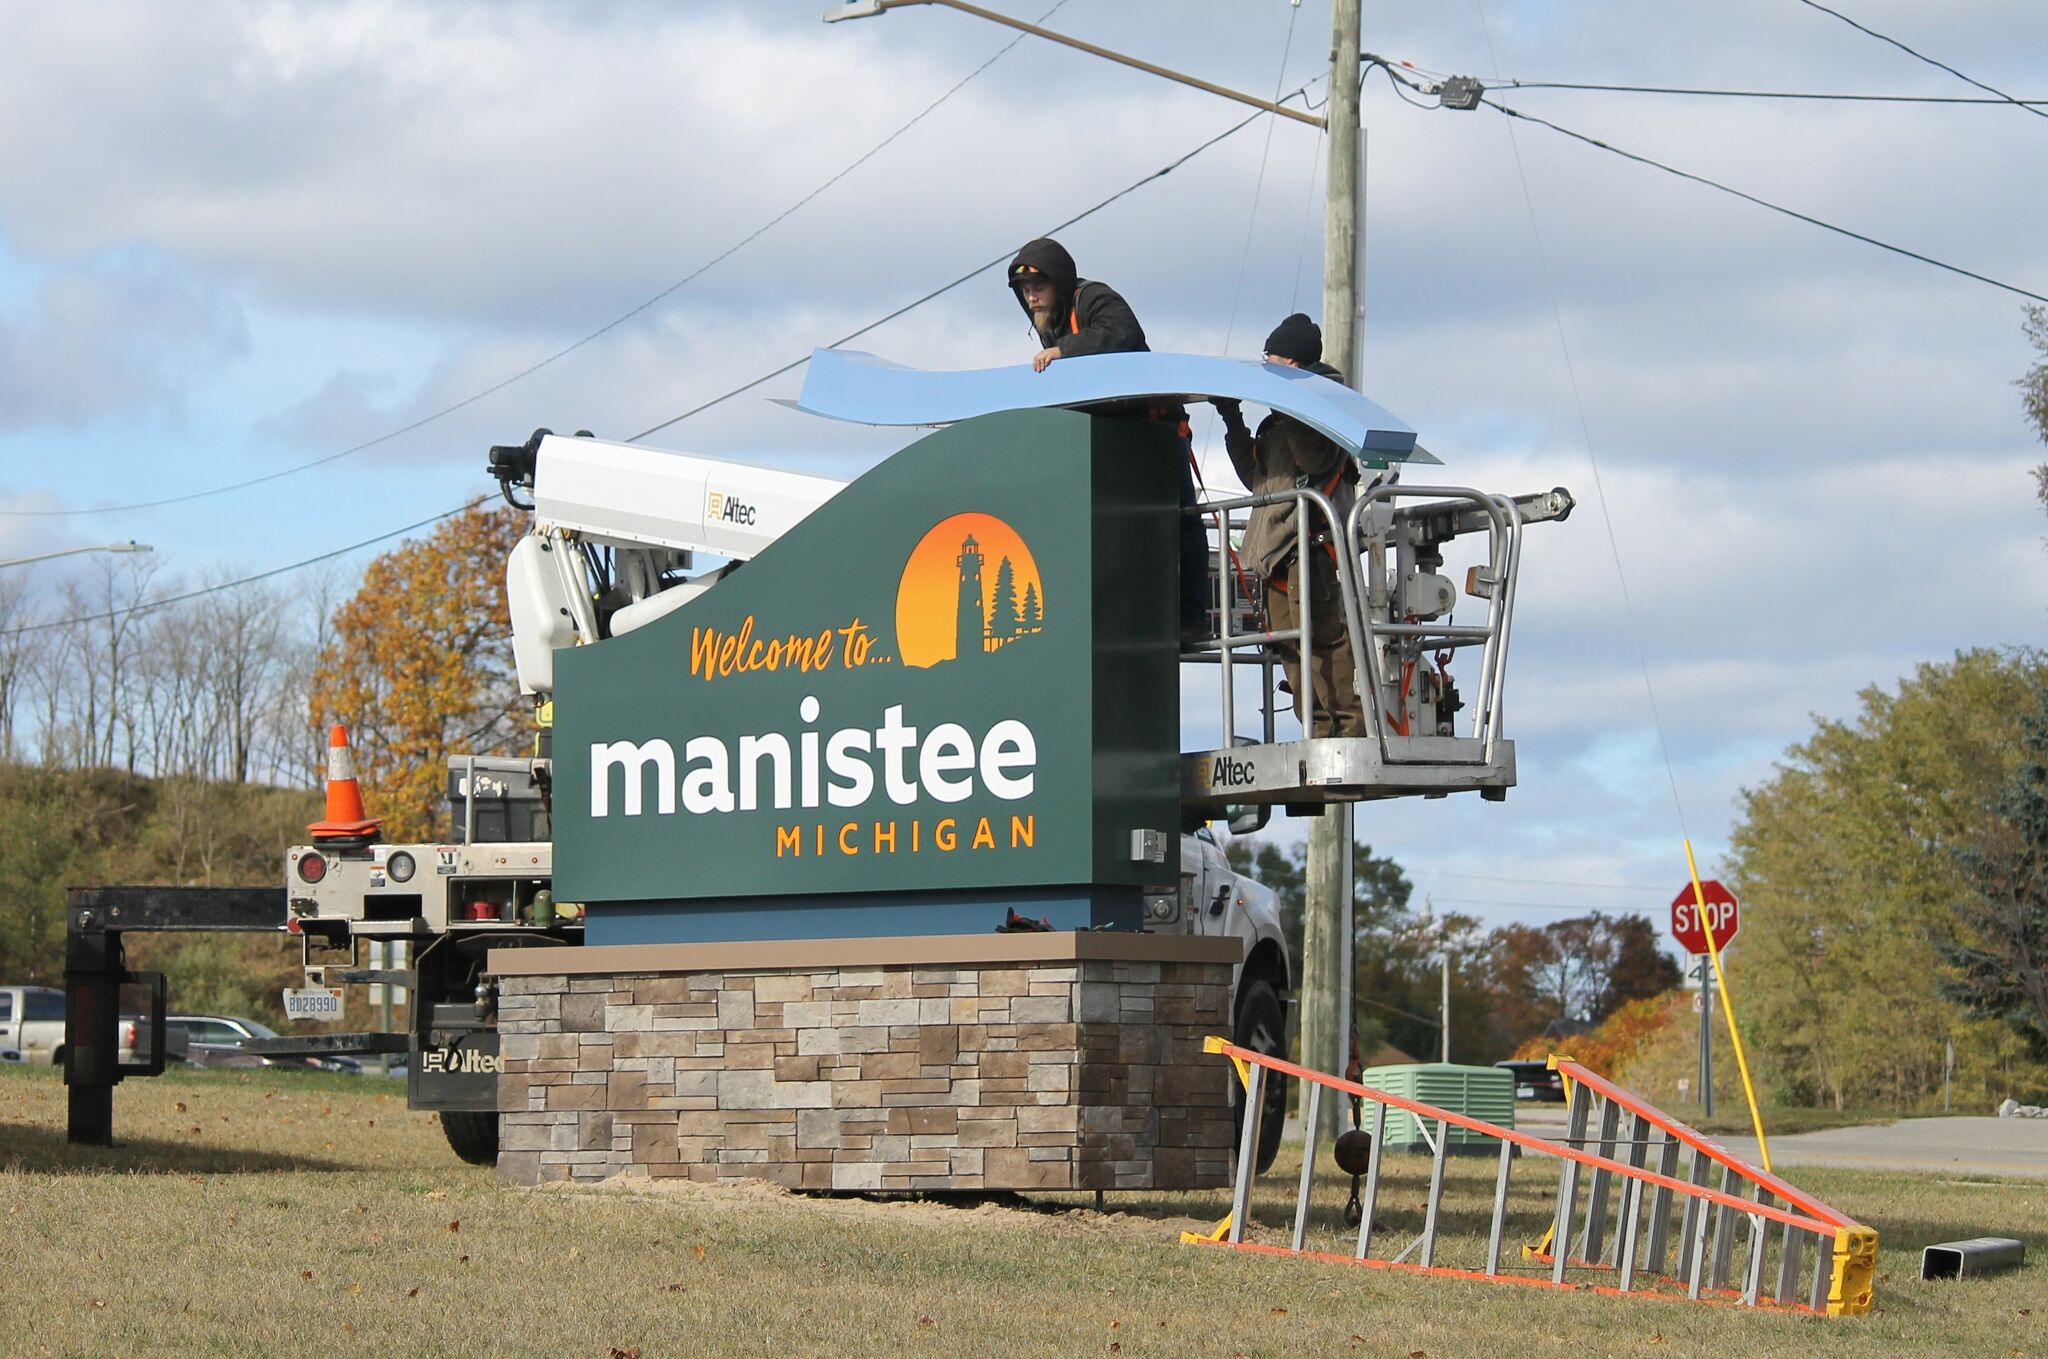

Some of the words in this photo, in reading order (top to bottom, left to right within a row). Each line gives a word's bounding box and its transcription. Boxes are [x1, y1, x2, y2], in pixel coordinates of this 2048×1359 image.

[722, 496, 756, 526] Altec
[690, 614, 834, 681] Welcome
[589, 695, 1038, 818] manistee
[1212, 756, 1255, 787] Altec
[776, 815, 1035, 857] MICHIGAN
[1676, 902, 1735, 933] STOP
